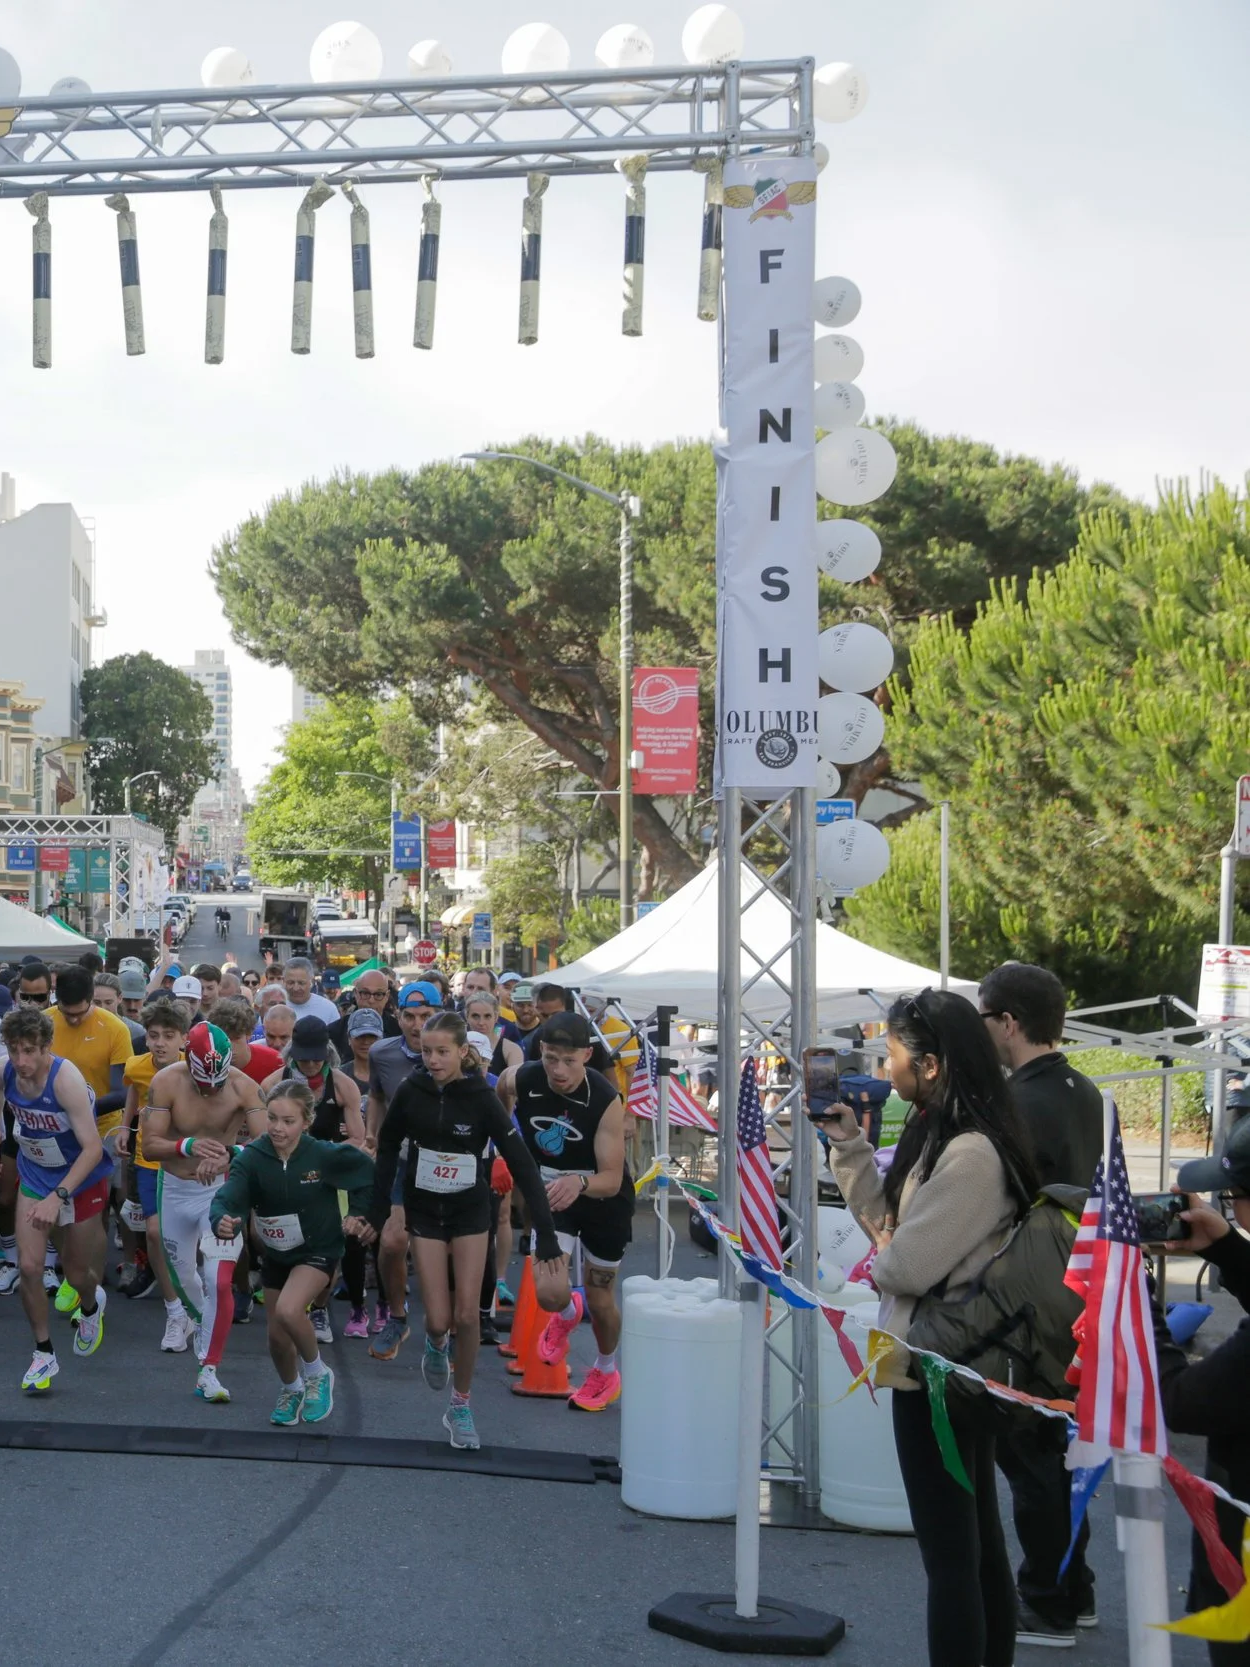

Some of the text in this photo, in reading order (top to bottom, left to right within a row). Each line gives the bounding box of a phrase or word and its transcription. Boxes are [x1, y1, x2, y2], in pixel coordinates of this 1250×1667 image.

[854, 439, 868, 485] COLUMBUS
[726, 711, 818, 734] OLUMBU
[842, 707, 867, 751] COLUMBUS
[828, 804, 852, 814] here
[414, 947, 436, 958] STOP
[30, 1147, 44, 1157] 58
[433, 1165, 459, 1180] 427
[129, 1211, 145, 1222] 128
[262, 1227, 285, 1239] 428
